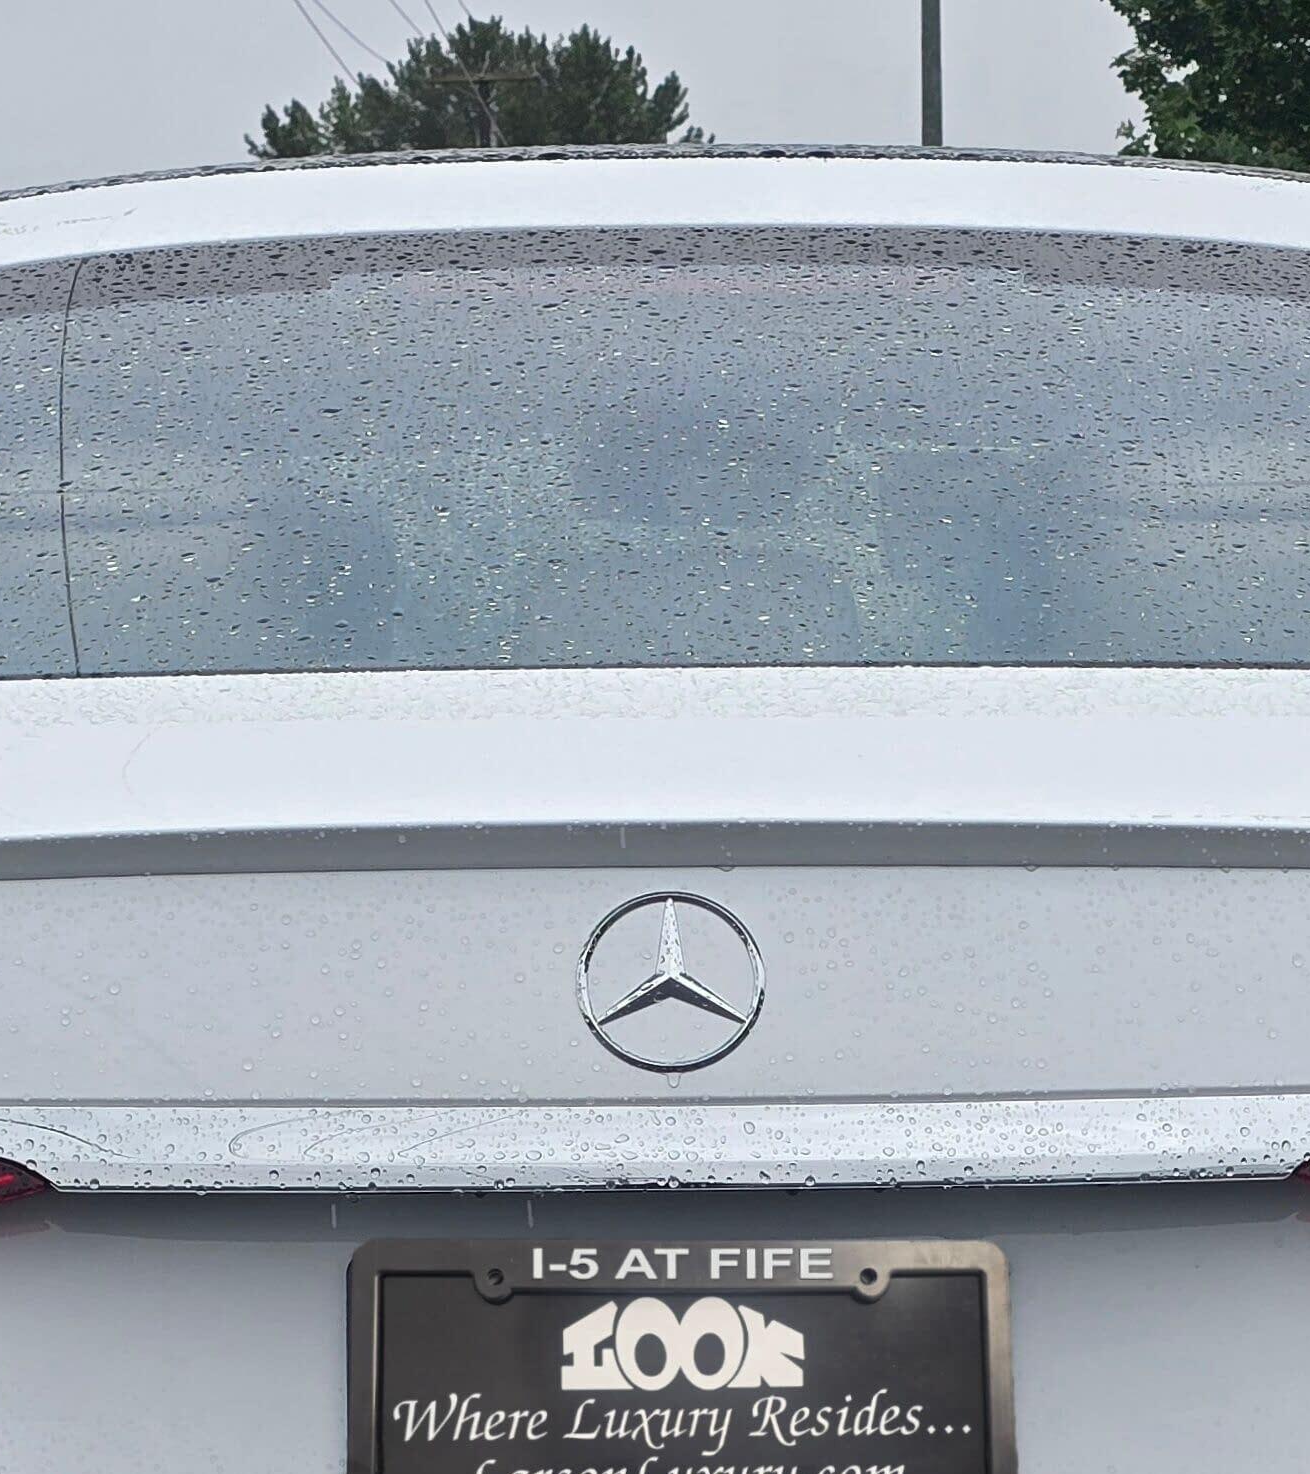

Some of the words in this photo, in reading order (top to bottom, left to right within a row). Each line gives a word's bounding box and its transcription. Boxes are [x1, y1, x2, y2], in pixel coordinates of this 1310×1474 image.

[532, 1247, 599, 1280] I-5
[615, 1247, 690, 1280] AT
[709, 1247, 834, 1280] FIFE
[561, 1297, 805, 1391] LOOK
[393, 1393, 549, 1442] Where
[563, 1399, 730, 1456] Luxury
[751, 1388, 971, 1446] Resides...
